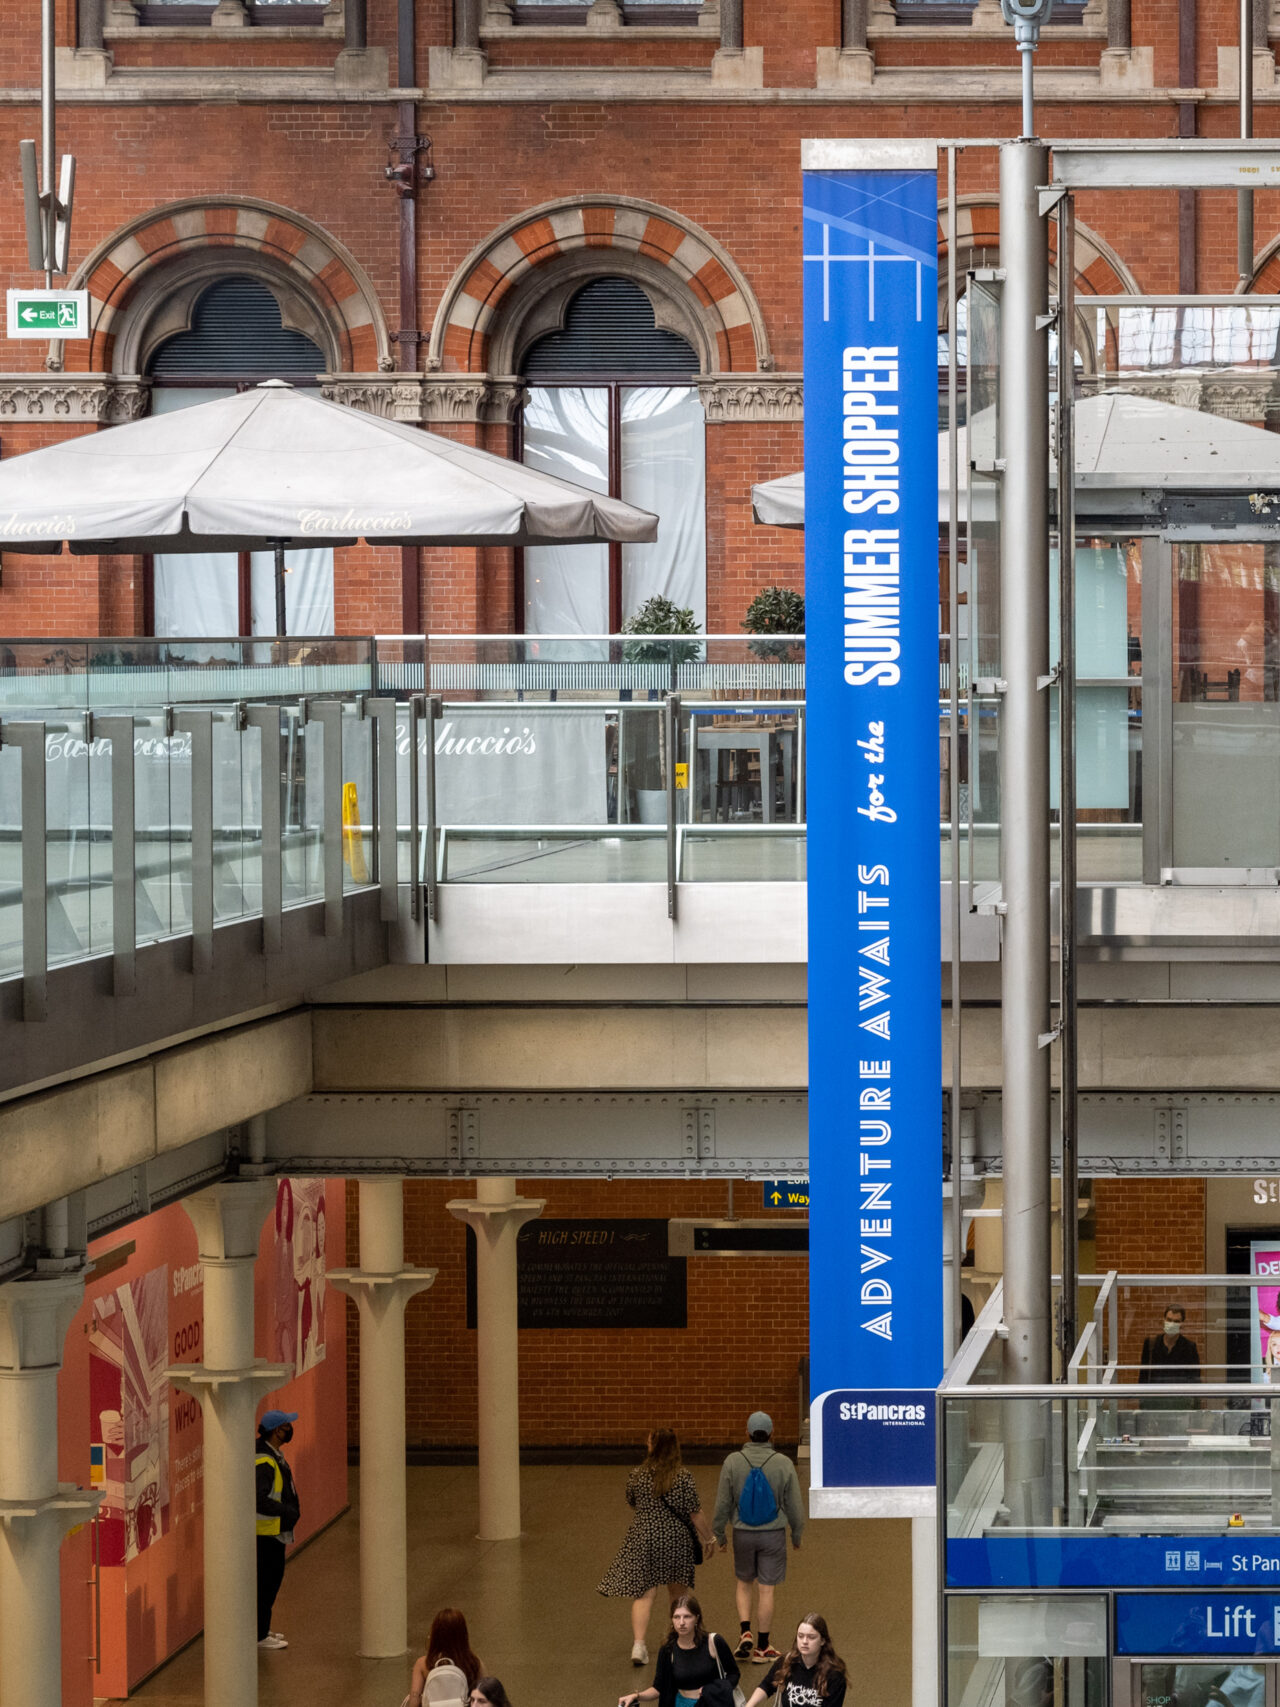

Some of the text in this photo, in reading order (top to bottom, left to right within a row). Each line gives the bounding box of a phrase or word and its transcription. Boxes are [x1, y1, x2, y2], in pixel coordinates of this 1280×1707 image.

[40, 311, 55, 319] Exit
[298, 508, 412, 533] Carluccio's
[843, 346, 900, 1340] ADVENTURE AWAITS for the SUMMER SHOPPER
[788, 1193, 809, 1206] Way
[538, 1231, 569, 1245] HIGH
[570, 1231, 608, 1245] SPEED
[174, 1321, 200, 1358] GOOD
[1232, 1555, 1248, 1572] St
[1207, 1605, 1256, 1637] Lift
[1146, 1696, 1171, 1705] SHOP
